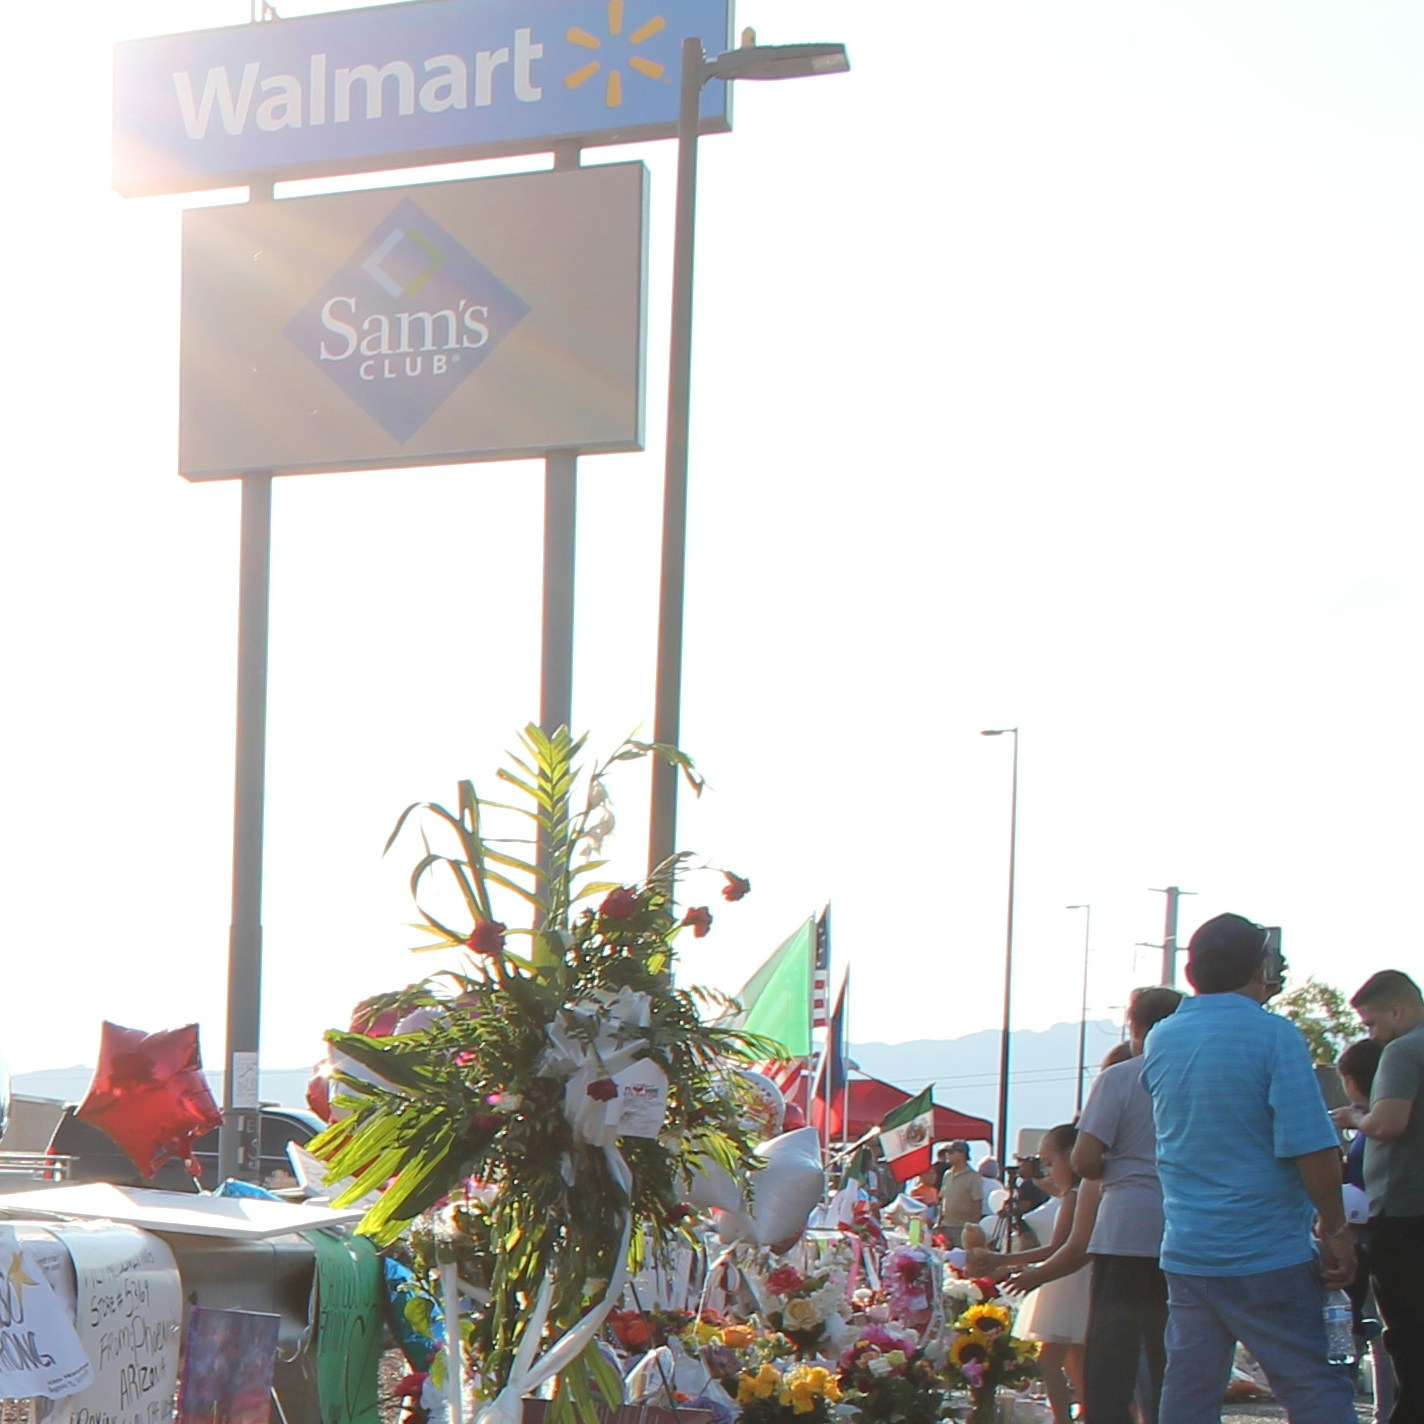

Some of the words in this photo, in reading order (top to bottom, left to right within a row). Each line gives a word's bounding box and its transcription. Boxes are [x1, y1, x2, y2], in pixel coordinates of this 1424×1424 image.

[173, 28, 543, 140] Walmart
[319, 296, 489, 361] Sam's
[359, 355, 448, 381] CLUB
